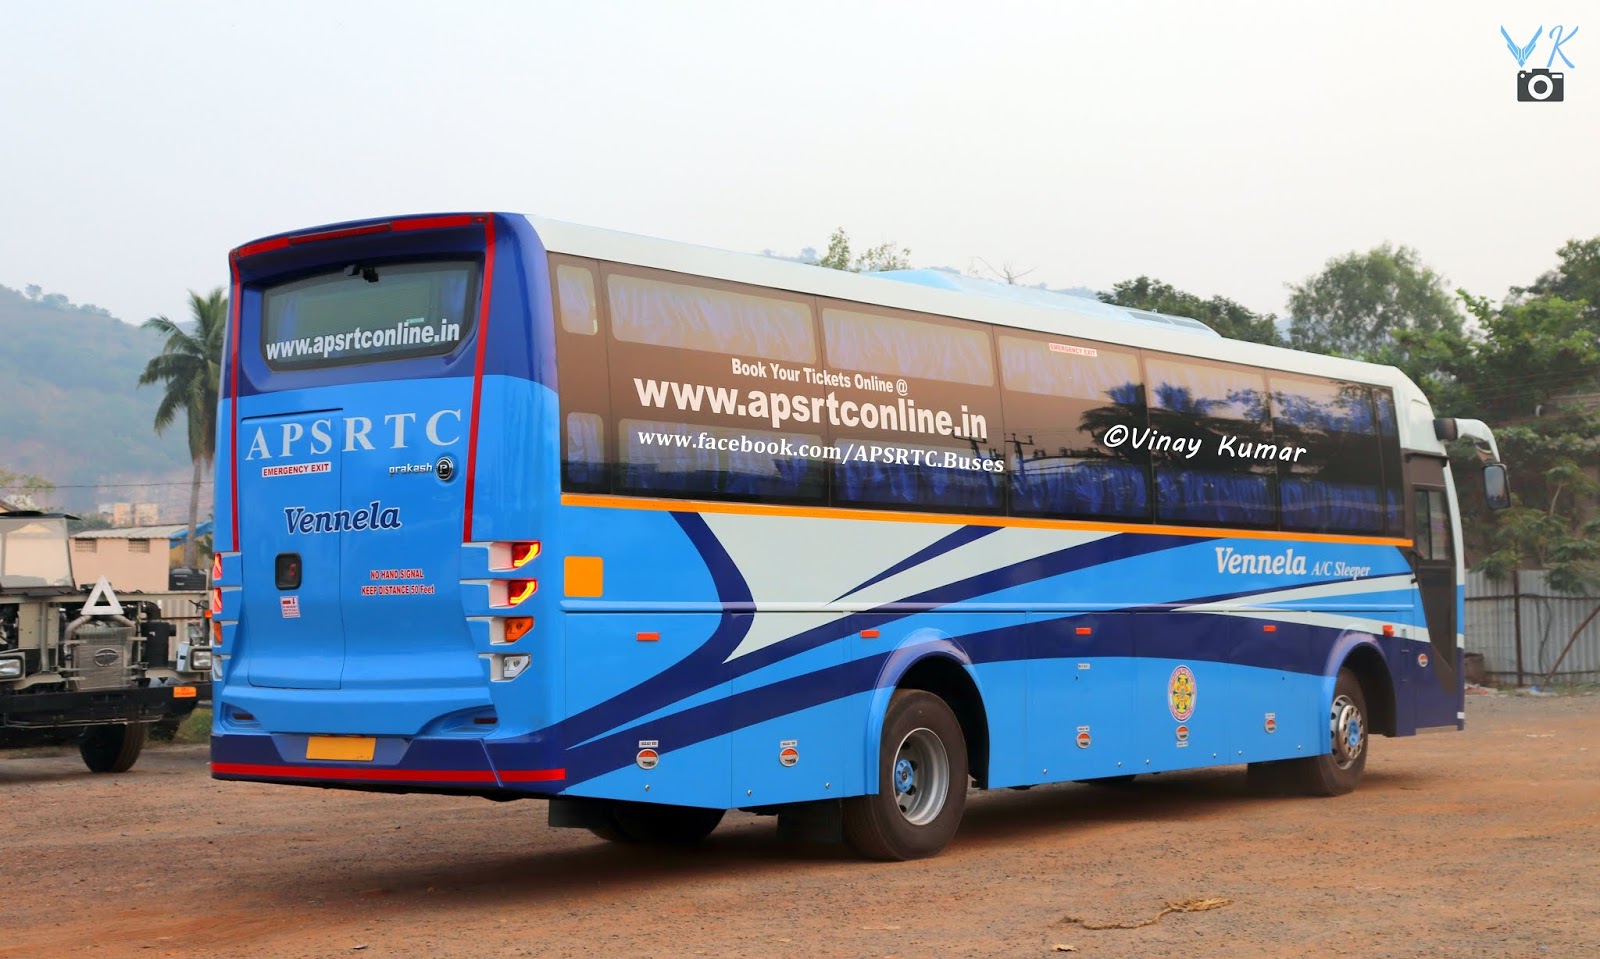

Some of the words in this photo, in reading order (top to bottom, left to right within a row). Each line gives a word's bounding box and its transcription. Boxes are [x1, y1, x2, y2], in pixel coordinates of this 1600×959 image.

[266, 318, 460, 360] www.apsrtconline.in
[731, 357, 767, 378] Book
[769, 363, 801, 382] Your
[803, 367, 851, 389] Tickets
[854, 373, 894, 393] Online
[896, 379, 908, 396] @
[633, 377, 987, 439] www.apsrtconline.in
[245, 409, 462, 461] APSRTC
[637, 430, 1005, 473] www.facebook.com/APSRTC.Buses
[263, 464, 308, 476] EMERGENCY
[311, 463, 330, 472] EXIT
[388, 462, 433, 476] prakash
[284, 500, 403, 535] Vennela
[370, 570, 380, 579] NO
[381, 570, 399, 579] HAND
[400, 569, 424, 578] SIGNAL
[1215, 546, 1307, 576] Vennela
[1311, 561, 1333, 577] A/C
[1334, 562, 1371, 579] Sleeper
[361, 586, 377, 595] KEEP
[378, 585, 410, 595] DISTANCE
[420, 584, 434, 594] Feet
